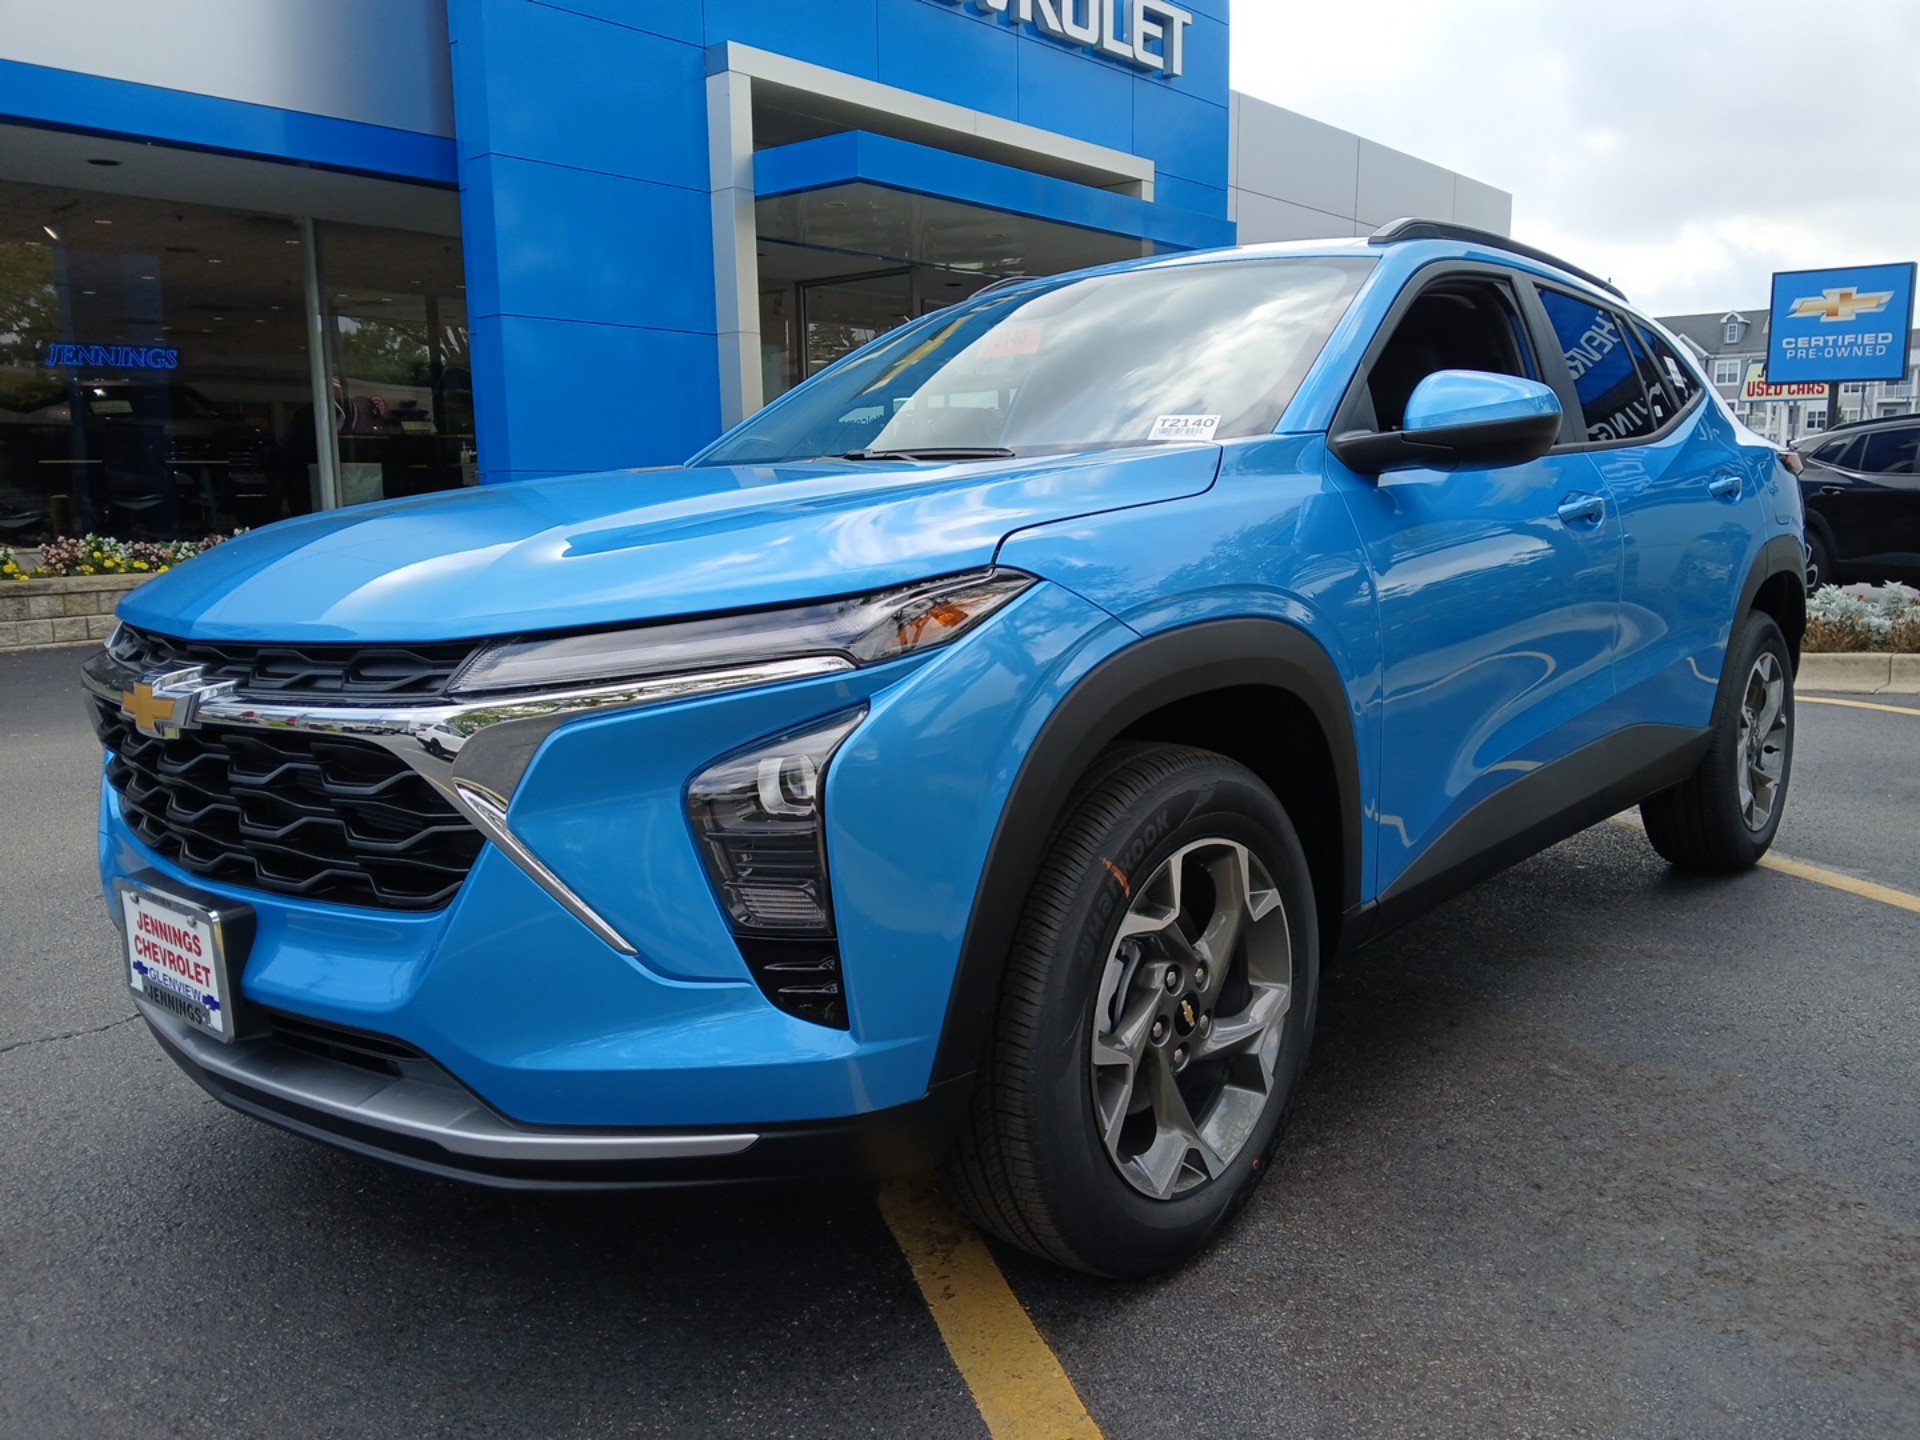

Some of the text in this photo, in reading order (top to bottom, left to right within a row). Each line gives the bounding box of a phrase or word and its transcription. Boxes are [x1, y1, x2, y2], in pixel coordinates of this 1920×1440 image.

[1782, 332, 1893, 349] CERTIFIED
[1786, 345, 1886, 360] PRE-OWNED
[45, 343, 178, 369] JENNINGS
[1747, 380, 1825, 397] USED CARS
[1160, 418, 1216, 428] T2140
[137, 911, 202, 958] JENNINGS
[134, 934, 211, 988] CHEVROLET
[149, 967, 202, 1002] GLENVIEW
[147, 985, 203, 1025] JENNINGS
